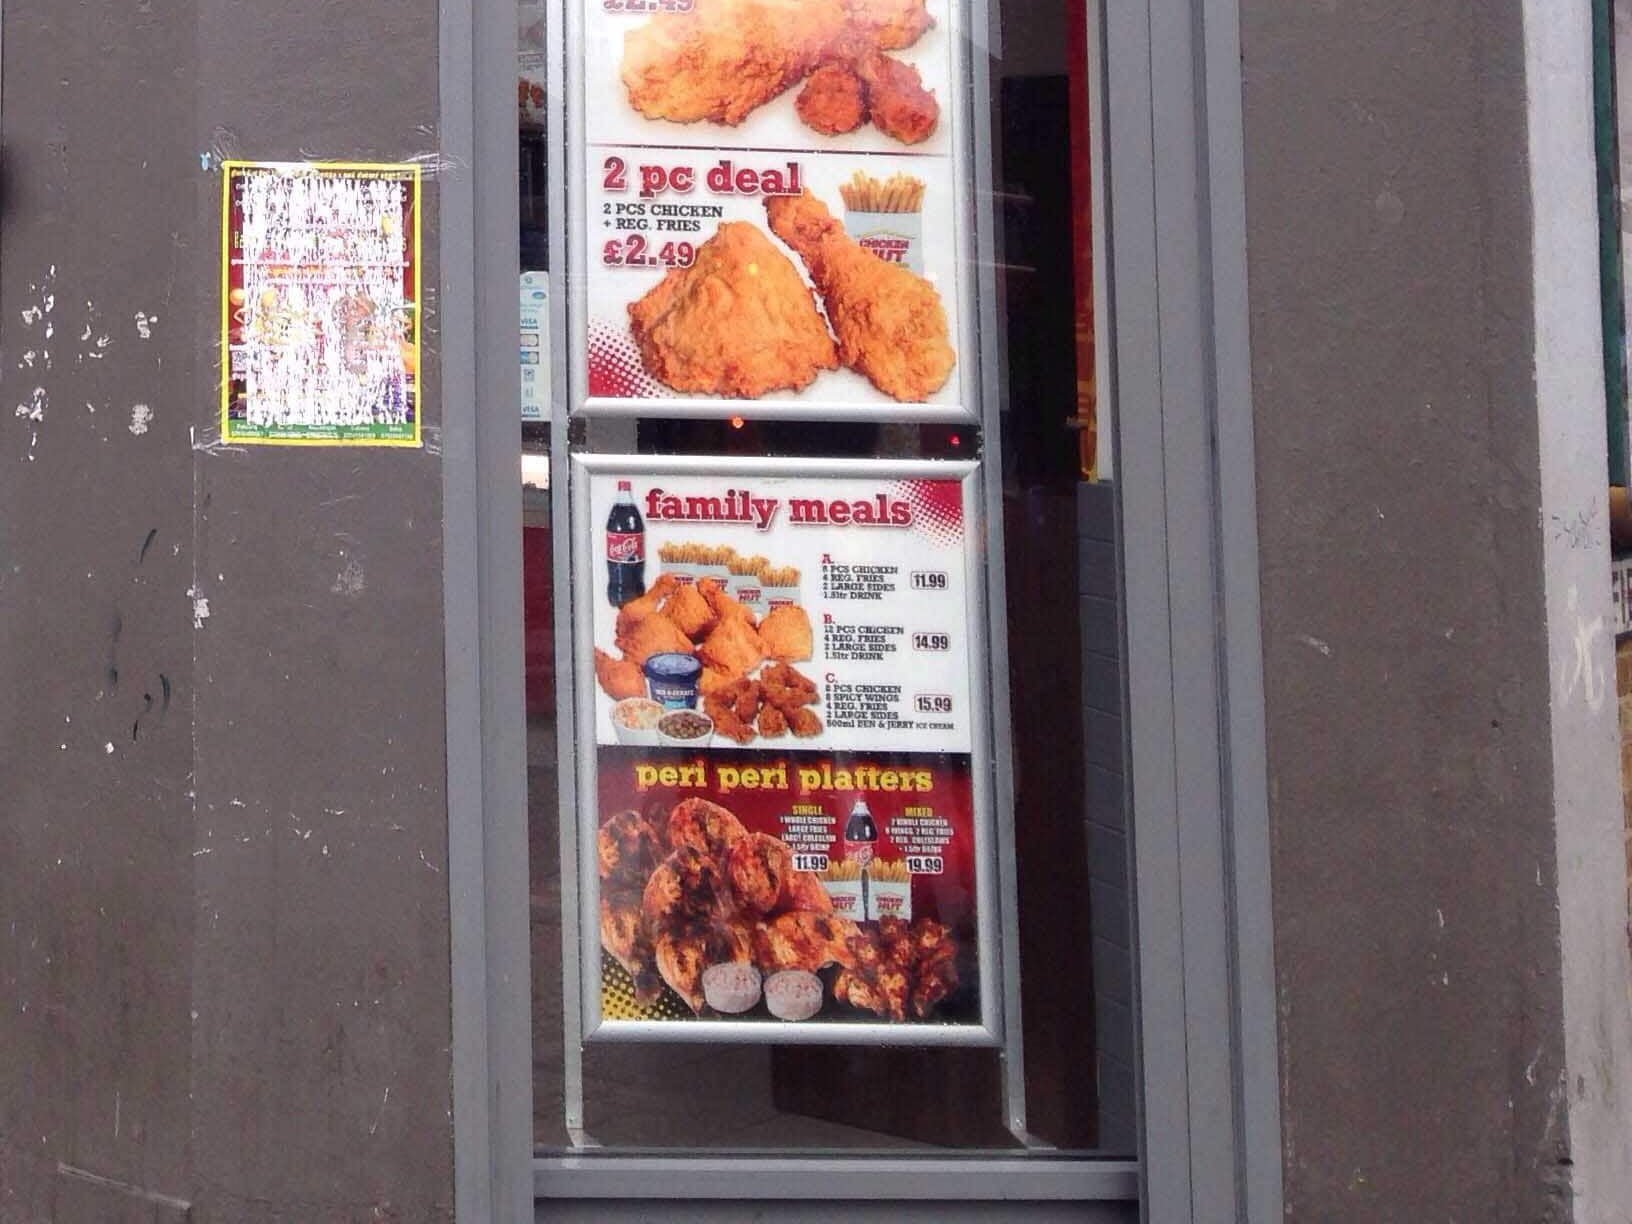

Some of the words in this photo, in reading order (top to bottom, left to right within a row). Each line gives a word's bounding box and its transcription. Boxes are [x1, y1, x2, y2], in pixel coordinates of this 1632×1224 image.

[603, 157, 626, 191] 2
[639, 167, 694, 199] pc
[706, 160, 803, 195] deal
[603, 203, 612, 216] 2
[615, 203, 647, 217] PCS
[650, 203, 724, 219] CHICKEN
[615, 218, 653, 232] REG.
[656, 219, 702, 232] FRIES
[603, 234, 695, 267] £2.49
[645, 487, 779, 532] family
[789, 493, 913, 527] meals
[822, 553, 835, 565] A.
[831, 565, 849, 574] PCS
[851, 565, 899, 575] CHICKEN
[856, 574, 885, 583] FRIES
[913, 573, 947, 589] 11.99
[831, 582, 865, 592] LARGE
[867, 583, 896, 592] SIDES
[849, 591, 883, 600] DRINK
[823, 614, 836, 625] B.
[836, 625, 856, 635] PCS
[857, 626, 905, 635] CHICKEN
[857, 635, 886, 644] FRIES
[915, 635, 949, 650] 14.99
[832, 643, 867, 652] LARGE
[868, 644, 897, 653] SIDES
[851, 652, 884, 661] DRINK
[825, 672, 838, 684] C.
[833, 684, 853, 694] PCS
[855, 685, 902, 694] CHICKEN
[833, 694, 863, 702] SPICY
[864, 694, 900, 703] WINGS
[860, 703, 889, 712] FRIES
[917, 697, 953, 712] 15.99
[834, 711, 869, 720] LARGE
[870, 712, 900, 720] SIDES
[878, 721, 887, 730] &
[887, 721, 915, 731] JERRY
[635, 761, 707, 793] peri
[717, 762, 789, 794] peri
[799, 766, 935, 795] platters
[795, 855, 828, 871] 11.99
[907, 857, 943, 873] 19.99
